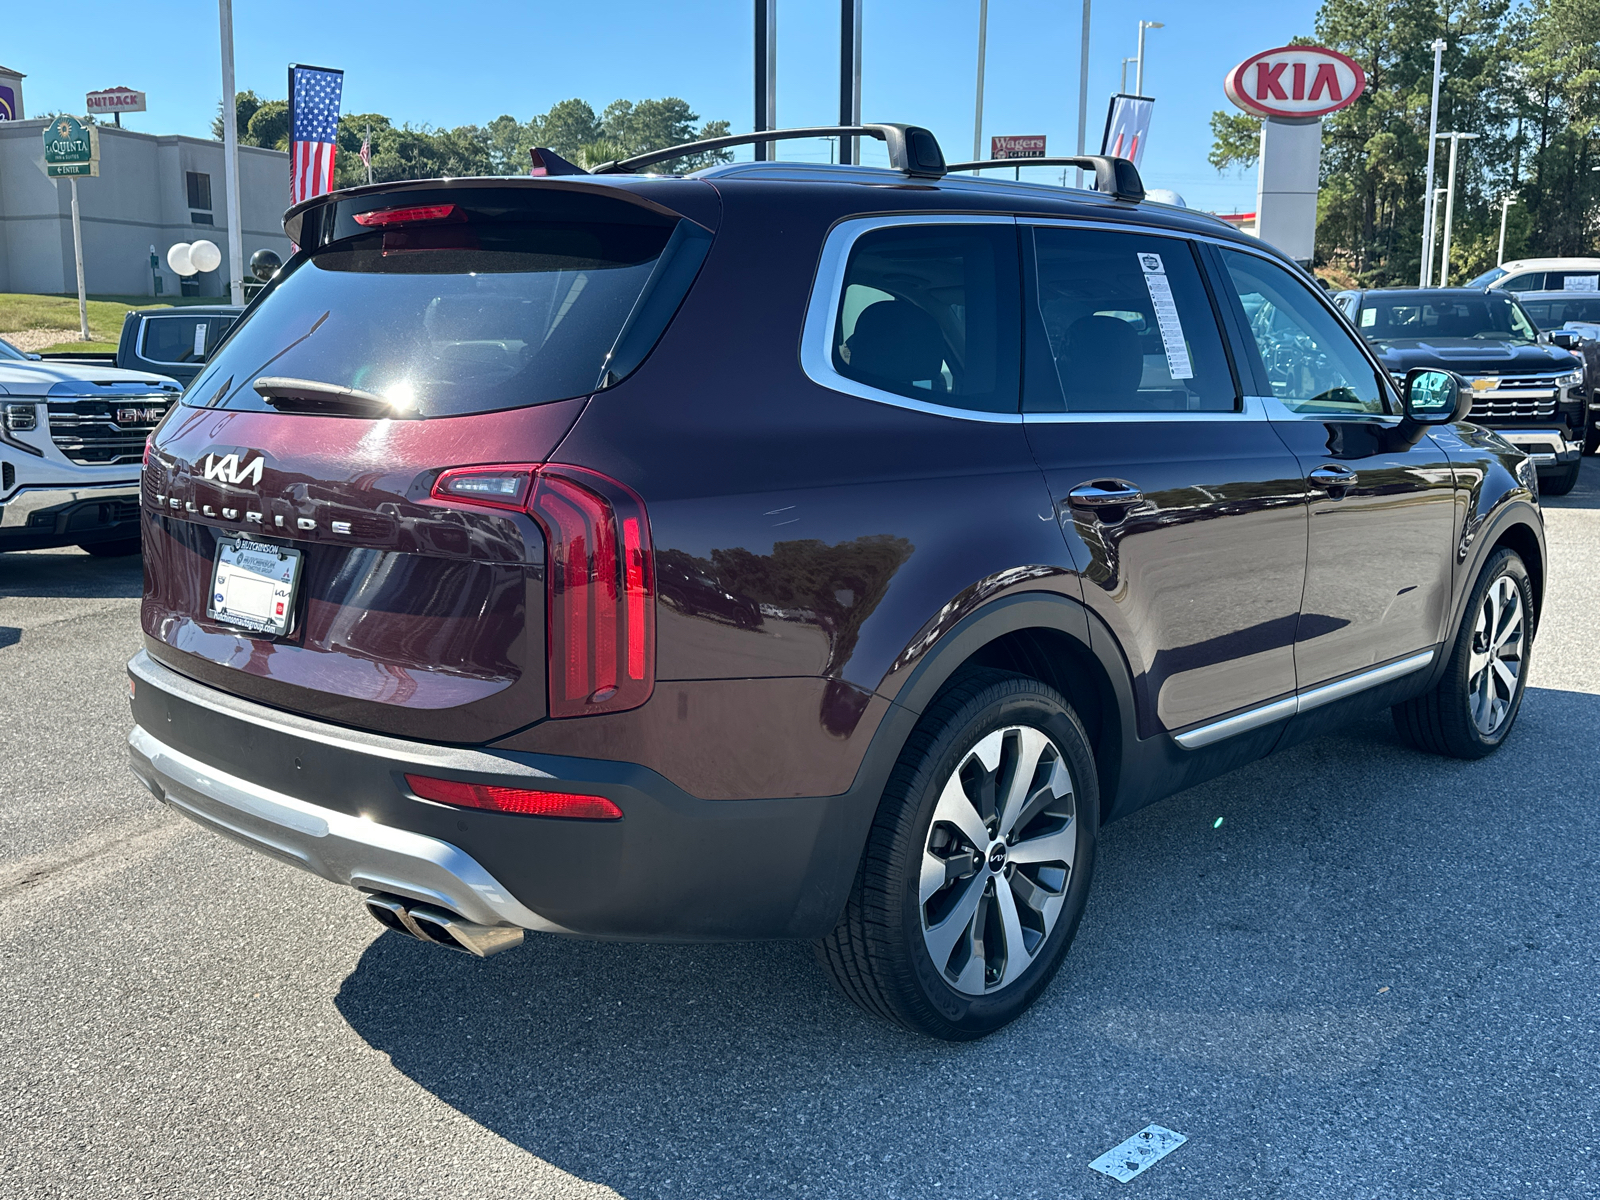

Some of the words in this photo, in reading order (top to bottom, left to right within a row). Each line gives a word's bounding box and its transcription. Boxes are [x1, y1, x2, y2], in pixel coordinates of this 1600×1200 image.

[1256, 62, 1343, 101] KIA
[86, 95, 137, 107] OUTBACK
[52, 140, 88, 155] QUINTA
[994, 137, 1044, 150] Wagers
[62, 166, 80, 174] ENTER
[117, 408, 166, 423] GMC
[204, 452, 265, 486] KIA
[156, 494, 352, 535] TELLURIDE
[240, 540, 279, 554] HUTCHINSON
